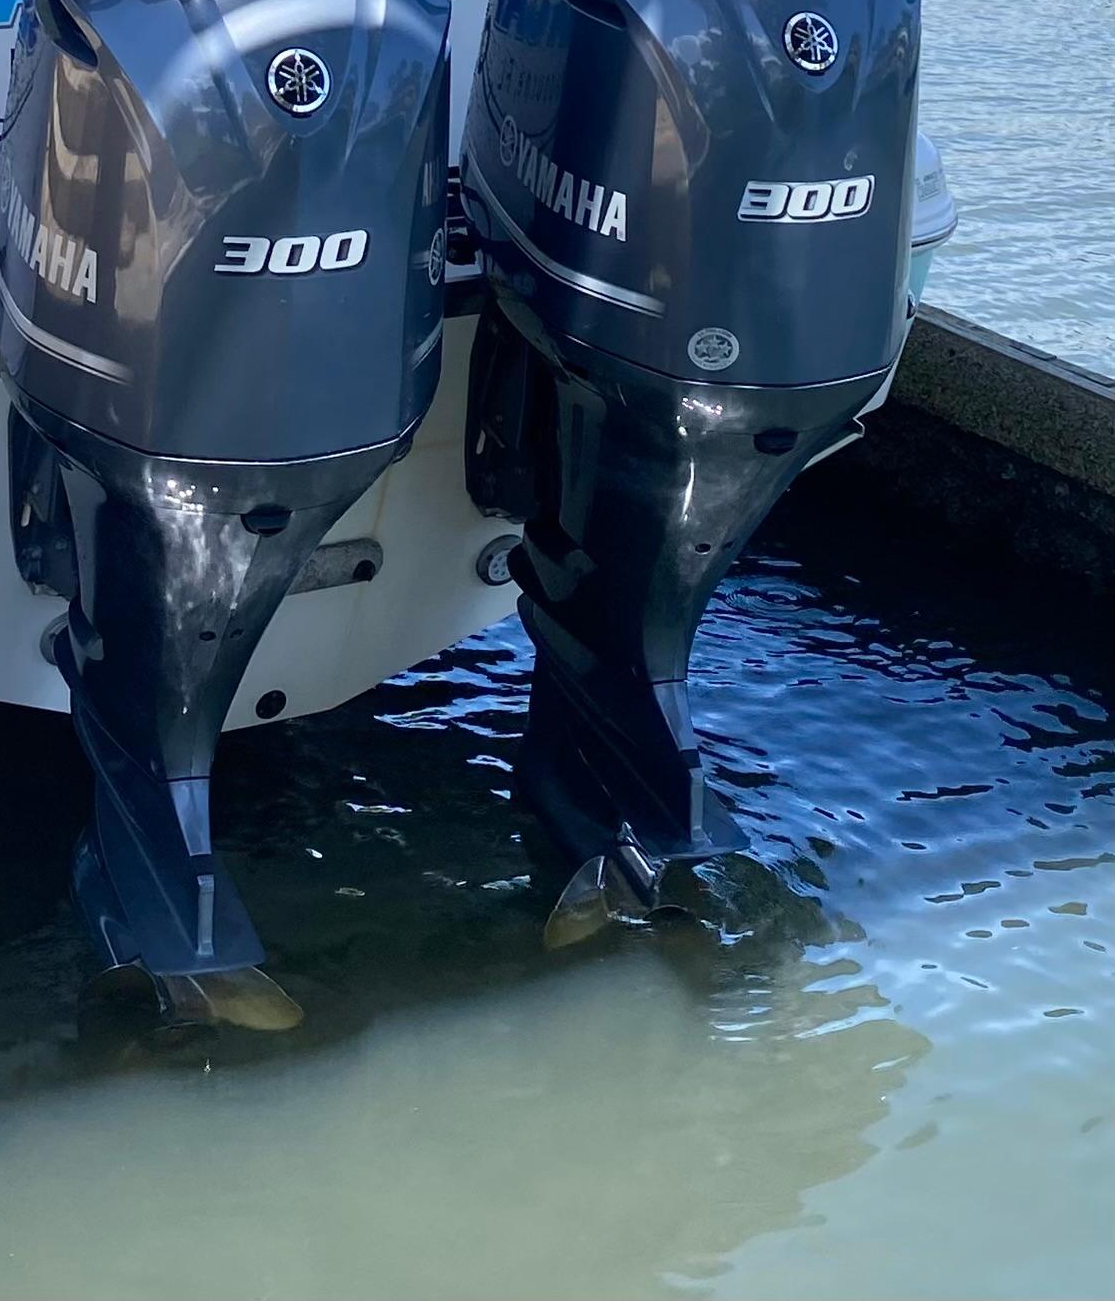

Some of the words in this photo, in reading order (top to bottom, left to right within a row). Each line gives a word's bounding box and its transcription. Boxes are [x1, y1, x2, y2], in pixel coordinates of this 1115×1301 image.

[517, 131, 627, 242] YAMAHA
[737, 174, 875, 223] 300
[7, 178, 98, 304] YAMAHA
[214, 229, 368, 275] 300
